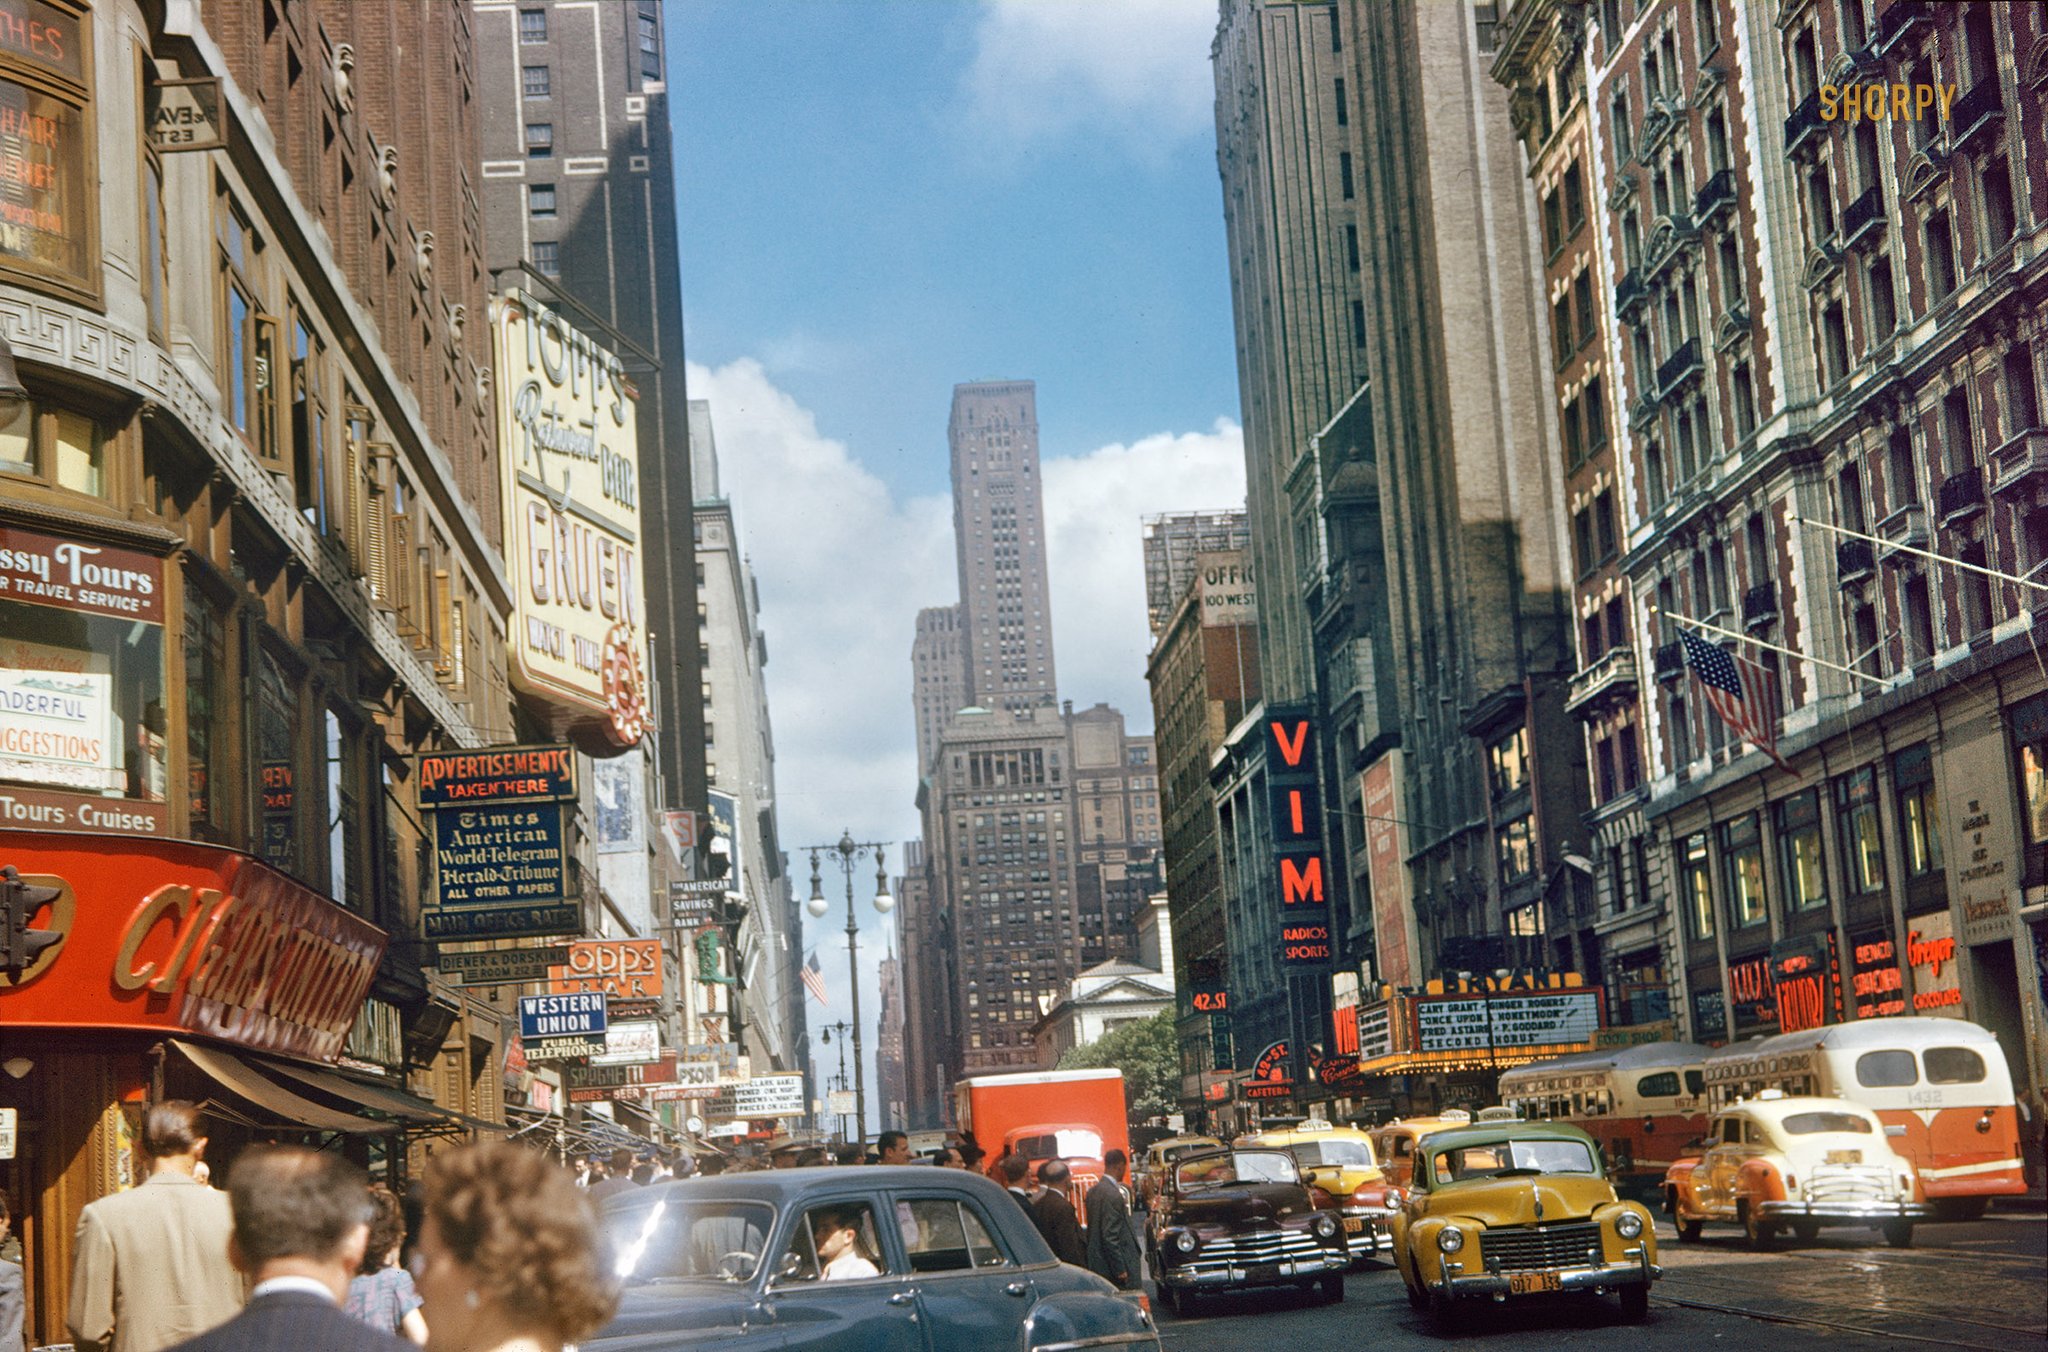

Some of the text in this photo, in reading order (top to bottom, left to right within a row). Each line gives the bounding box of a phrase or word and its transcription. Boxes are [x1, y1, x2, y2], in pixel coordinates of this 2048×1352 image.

[519, 289, 627, 428] TOPPS
[602, 443, 636, 512] BAR
[54, 543, 154, 595] Tours
[527, 501, 637, 633] GRUEN
[15, 578, 73, 601] TRAVEL
[1205, 592, 1255, 606] 100 WEST
[526, 614, 601, 675] WATCH TIME
[0, 727, 101, 762] GGESTIONS
[421, 750, 571, 790] ADVERTISEMENTS
[446, 778, 549, 798] TAKEN HERE
[1, 797, 156, 831] Tours Cruises
[459, 812, 540, 829] Times
[1271, 721, 1324, 903] VIM
[449, 829, 548, 847] American
[439, 846, 559, 865] World-Telegram
[440, 865, 560, 886] Herald-Tribune
[447, 883, 556, 899] ALL OTHER PAPERS
[684, 879, 730, 891] AMERICAN
[673, 899, 714, 911] SAVINGS
[1284, 927, 1328, 940] RADIOS
[1286, 946, 1329, 958] SPORTS
[443, 955, 487, 969] DIENER
[562, 943, 655, 986] opps
[481, 967, 510, 977] ROOM
[1442, 966, 1571, 994] BRYANT
[524, 994, 602, 1015] WESTERN
[1420, 1005, 1444, 1014] CARY
[1448, 1002, 1478, 1012] GRANT
[1490, 1000, 1523, 1010] GINGER
[537, 1014, 591, 1034] UNION
[1457, 1014, 1483, 1022] UPON
[1422, 1027, 1447, 1036] FRED
[541, 1037, 589, 1048] PUBLIC
[524, 1043, 604, 1061] TELEPHONES
[613, 1088, 641, 1099] BEER
[1247, 1087, 1291, 1097] CAFETERIA
[1906, 1091, 1943, 1104] 1432
